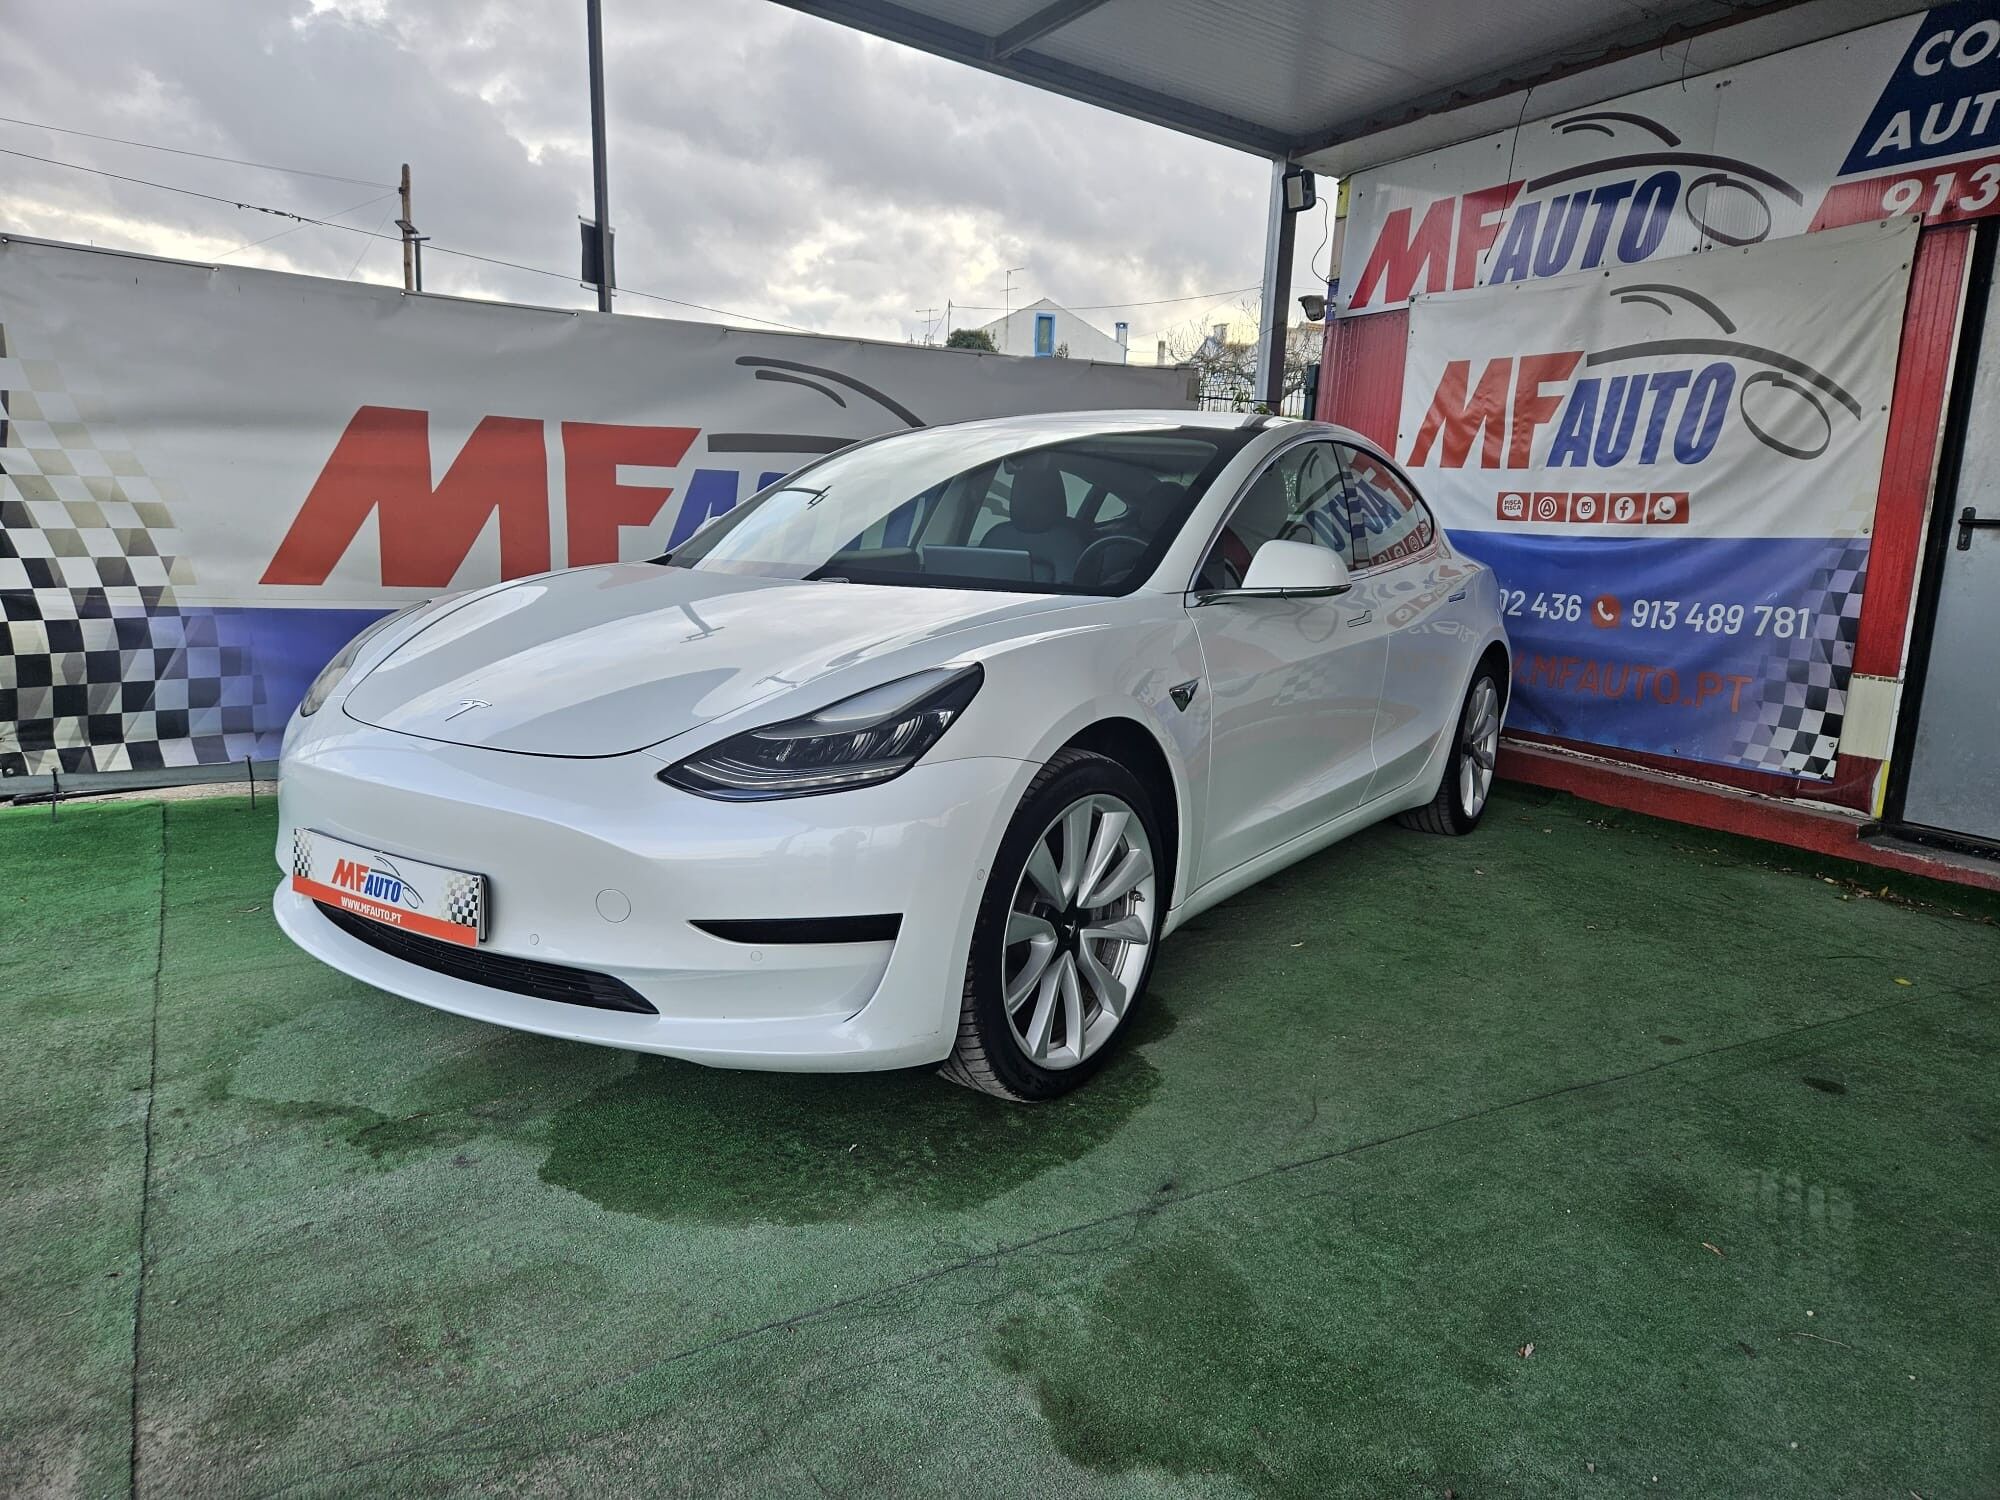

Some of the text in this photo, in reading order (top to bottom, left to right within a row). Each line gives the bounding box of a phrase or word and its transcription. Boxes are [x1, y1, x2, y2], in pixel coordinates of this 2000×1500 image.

[1913, 19, 2000, 76] CO
[1882, 163, 2000, 218] 913
[1531, 592, 1582, 622] 436
[1631, 599, 1680, 630] 913
[1685, 602, 1744, 635] 489
[1753, 605, 1810, 639] 781
[341, 895, 402, 924] WWW.MFAUTO.PT
